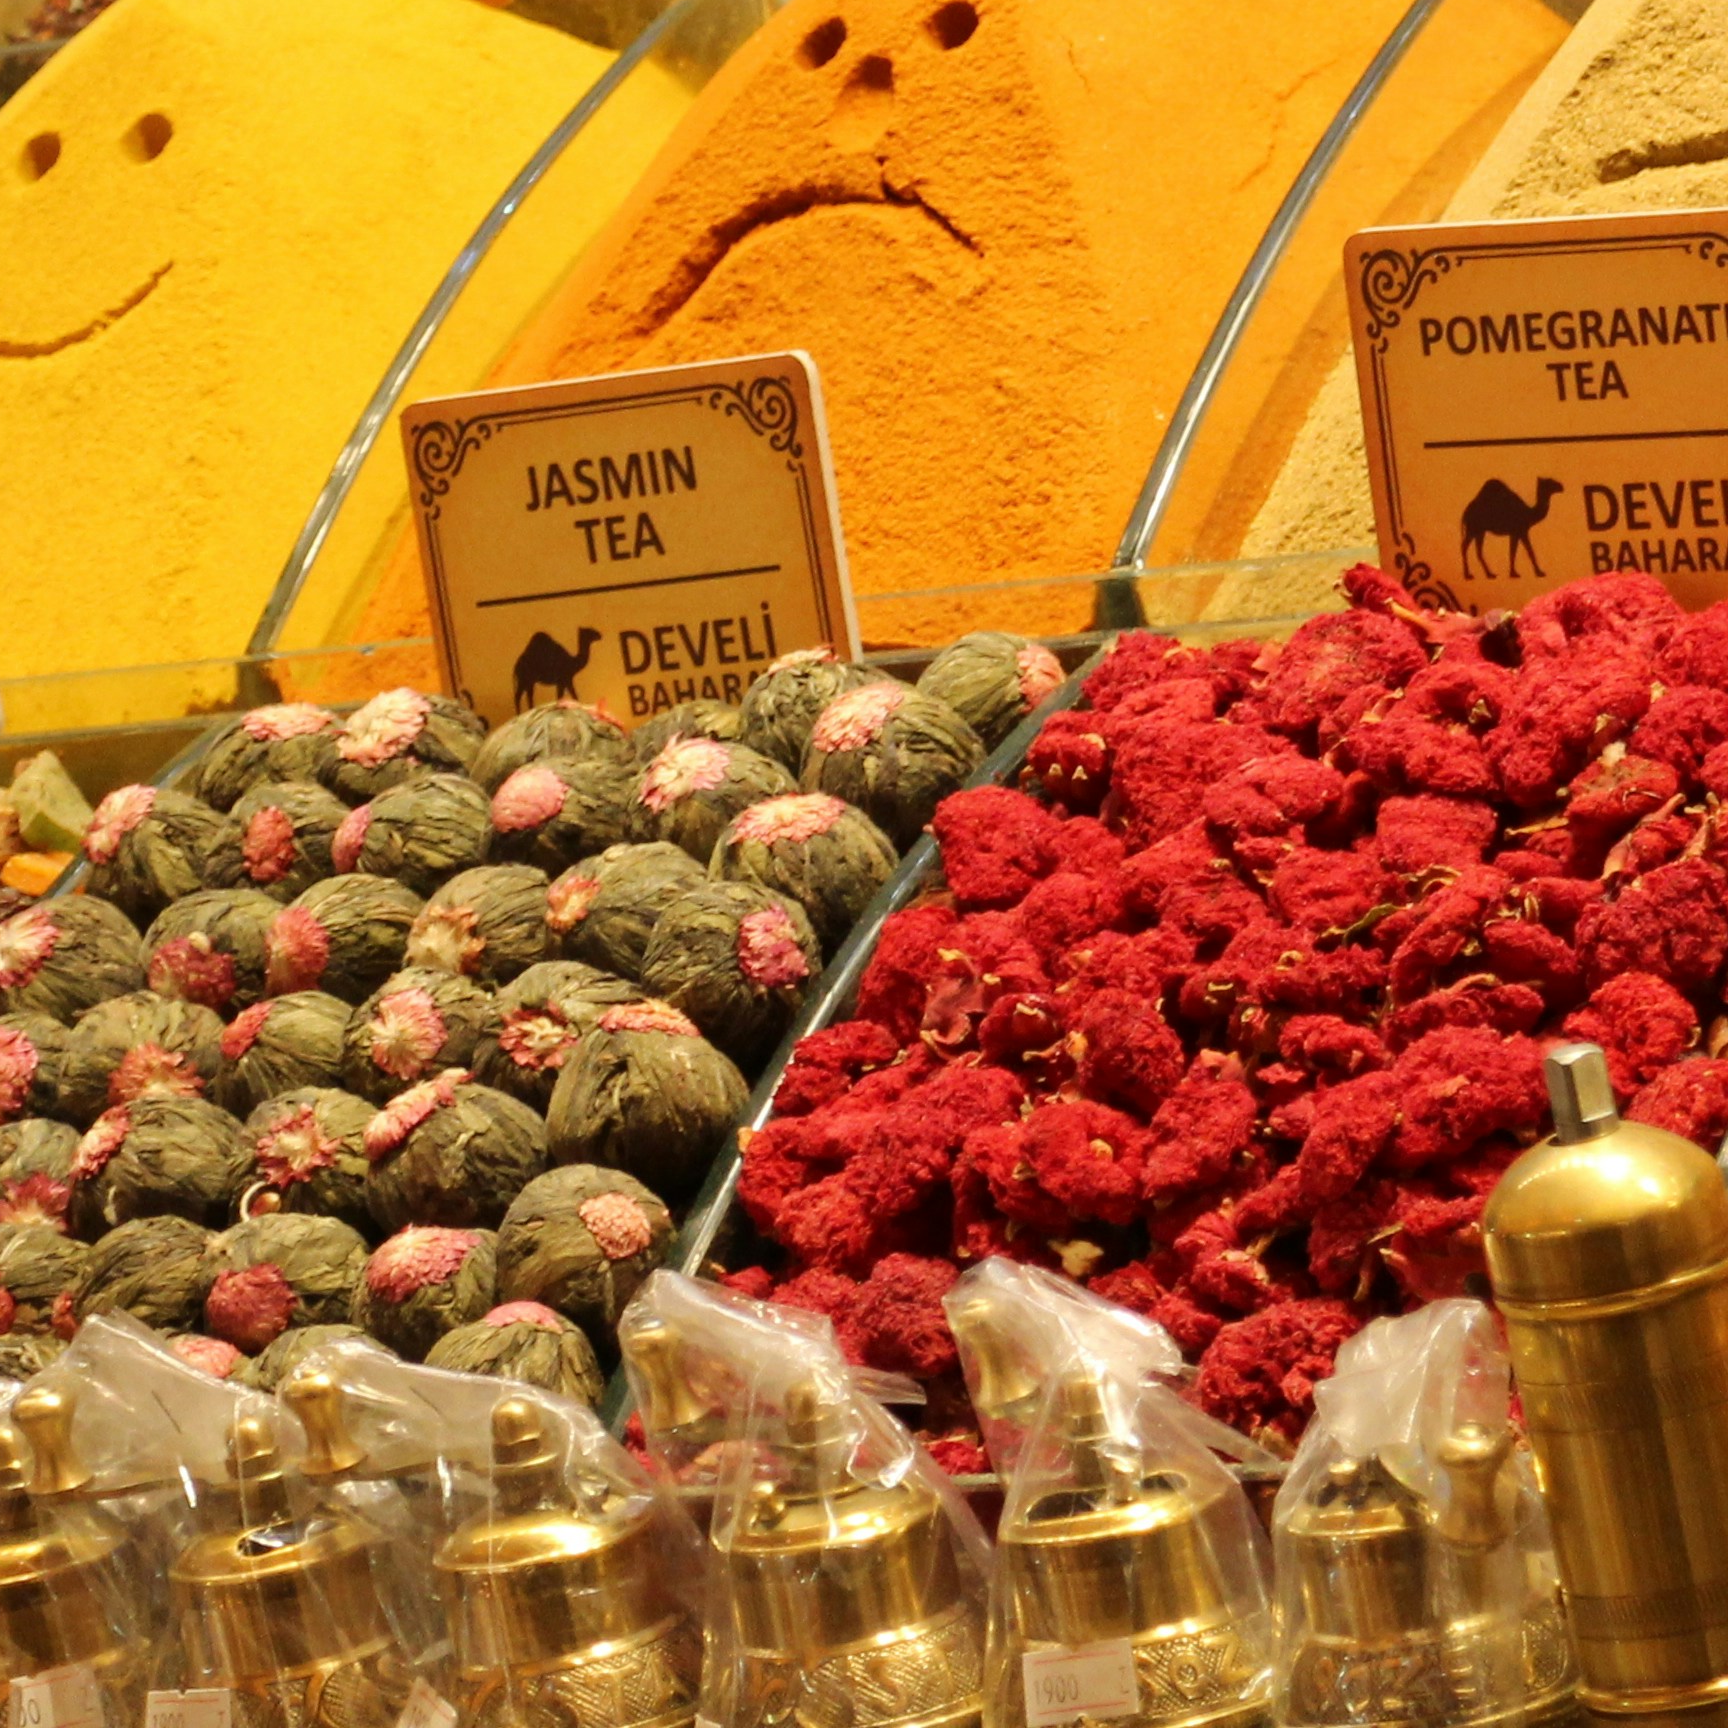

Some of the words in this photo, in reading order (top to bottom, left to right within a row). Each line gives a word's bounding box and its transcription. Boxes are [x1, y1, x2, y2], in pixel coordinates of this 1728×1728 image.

[1546, 360, 1629, 402] TEA
[526, 445, 698, 512] JASMIN
[575, 512, 666, 564] TEA
